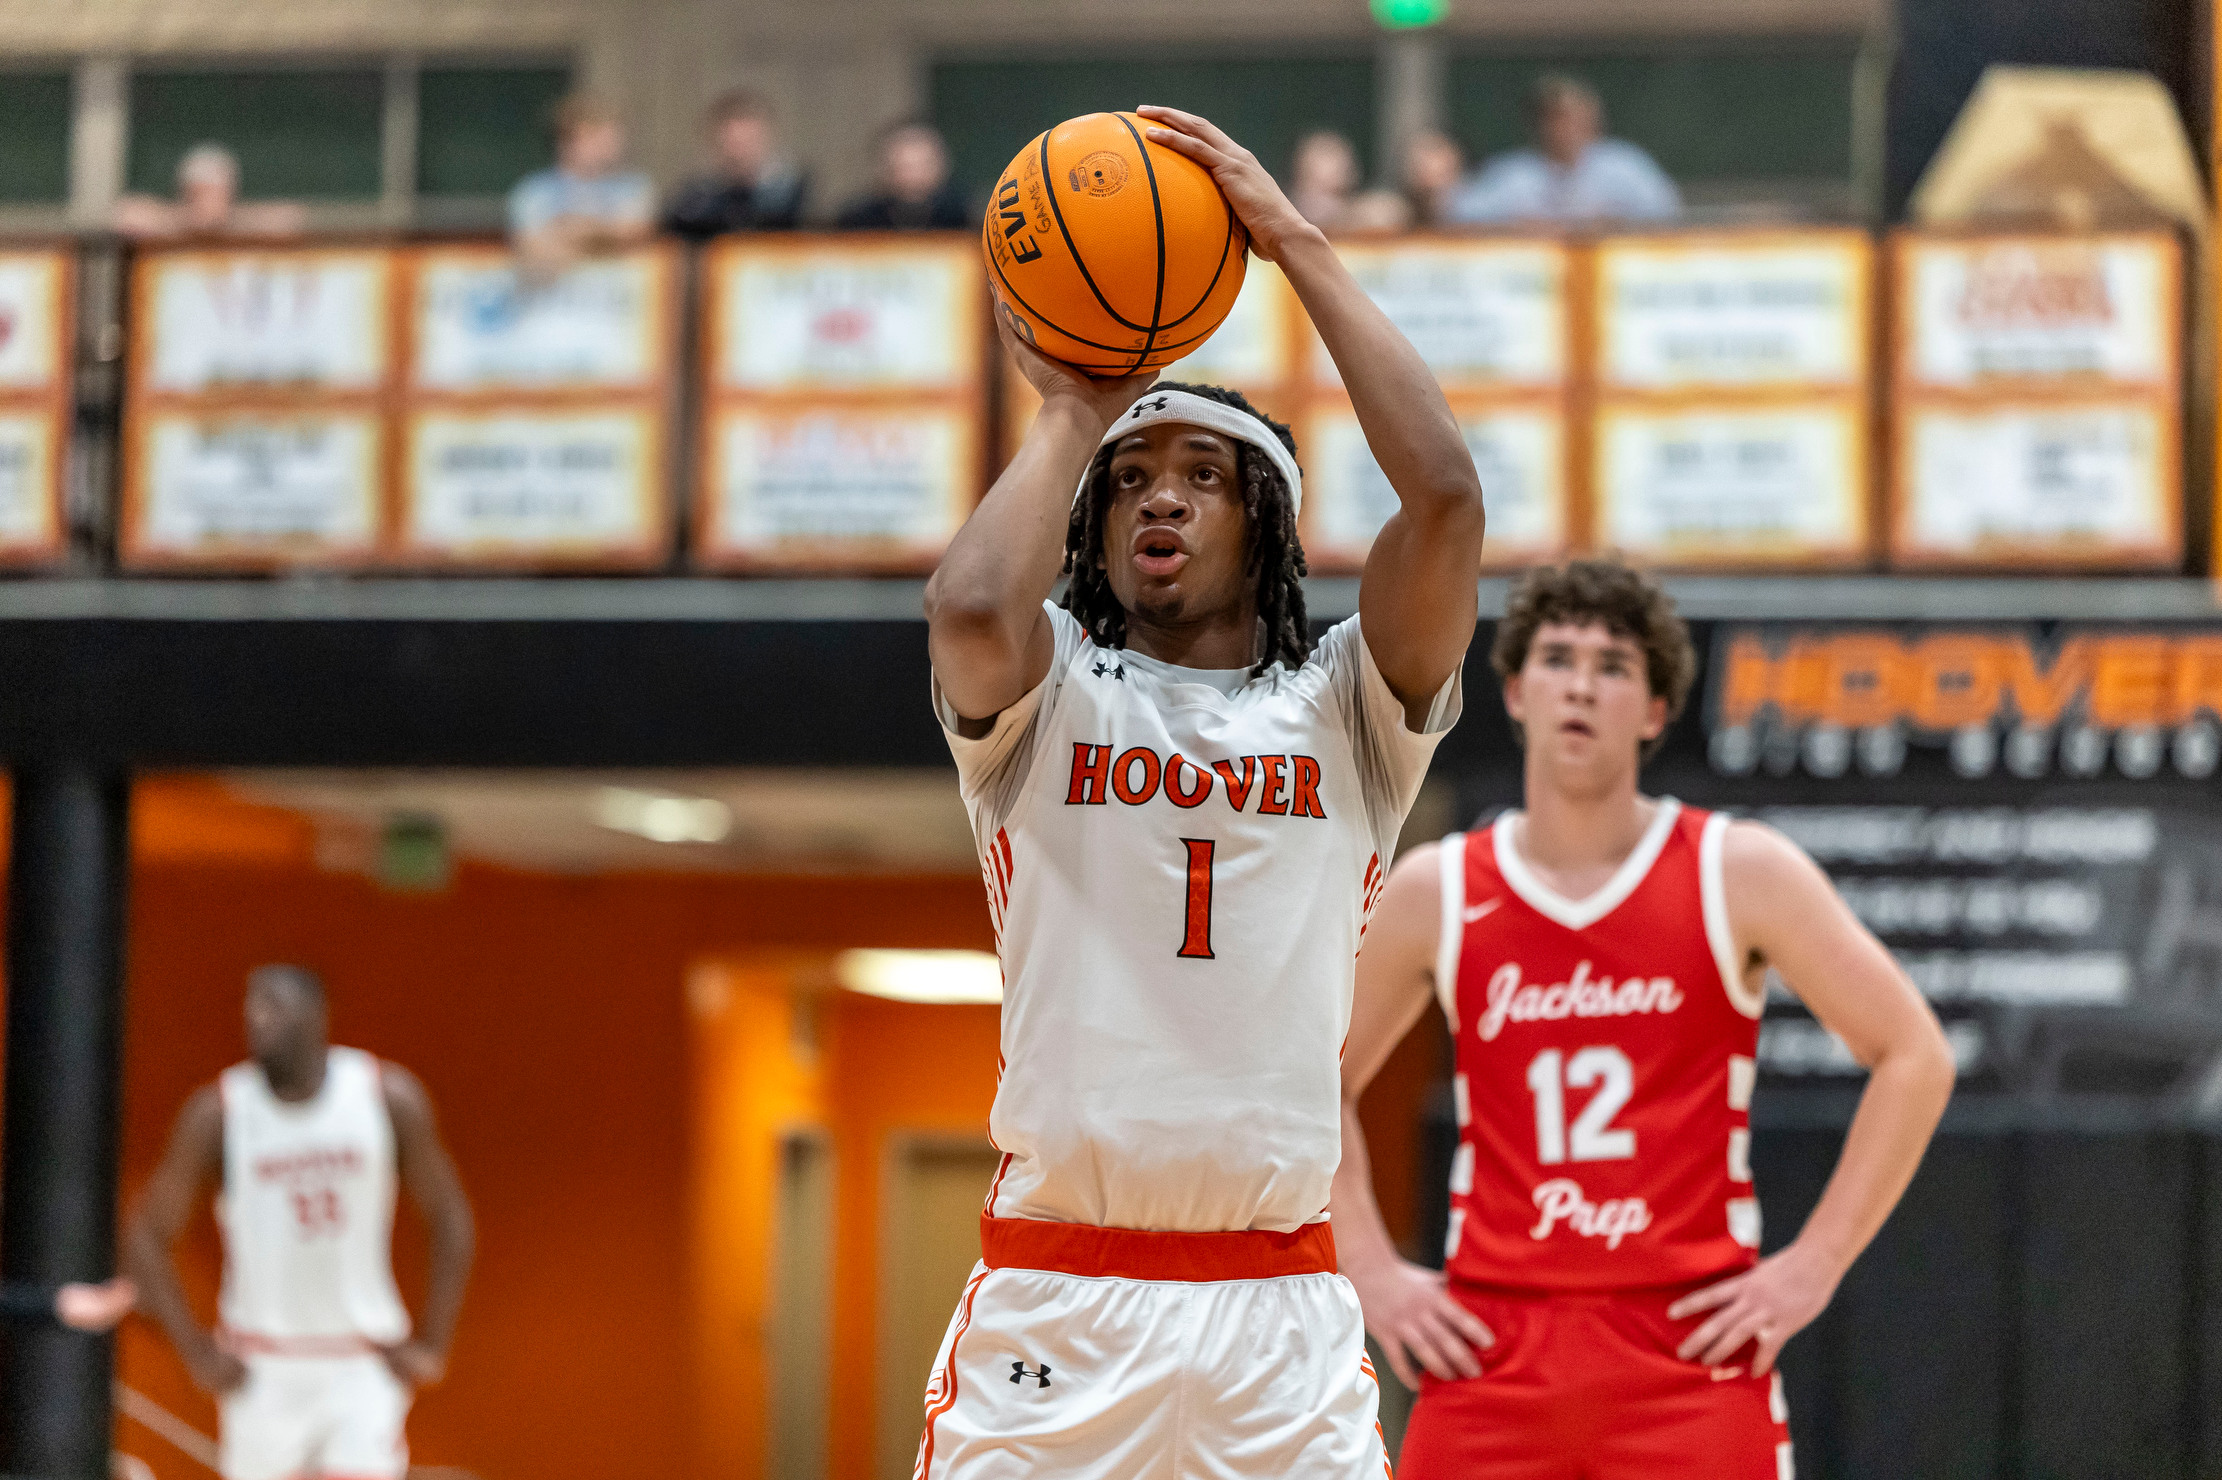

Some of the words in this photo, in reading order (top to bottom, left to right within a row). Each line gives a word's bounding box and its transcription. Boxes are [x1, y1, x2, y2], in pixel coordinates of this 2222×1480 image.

[999, 179, 1042, 264] EVO
[1029, 181, 1051, 234] GAME
[1065, 742, 1328, 819] HOOVER
[1177, 838, 1215, 959] 1
[1477, 959, 1684, 1042] Jackson
[1527, 1045, 1636, 1165] 12
[1530, 1177, 1653, 1251] Prep
